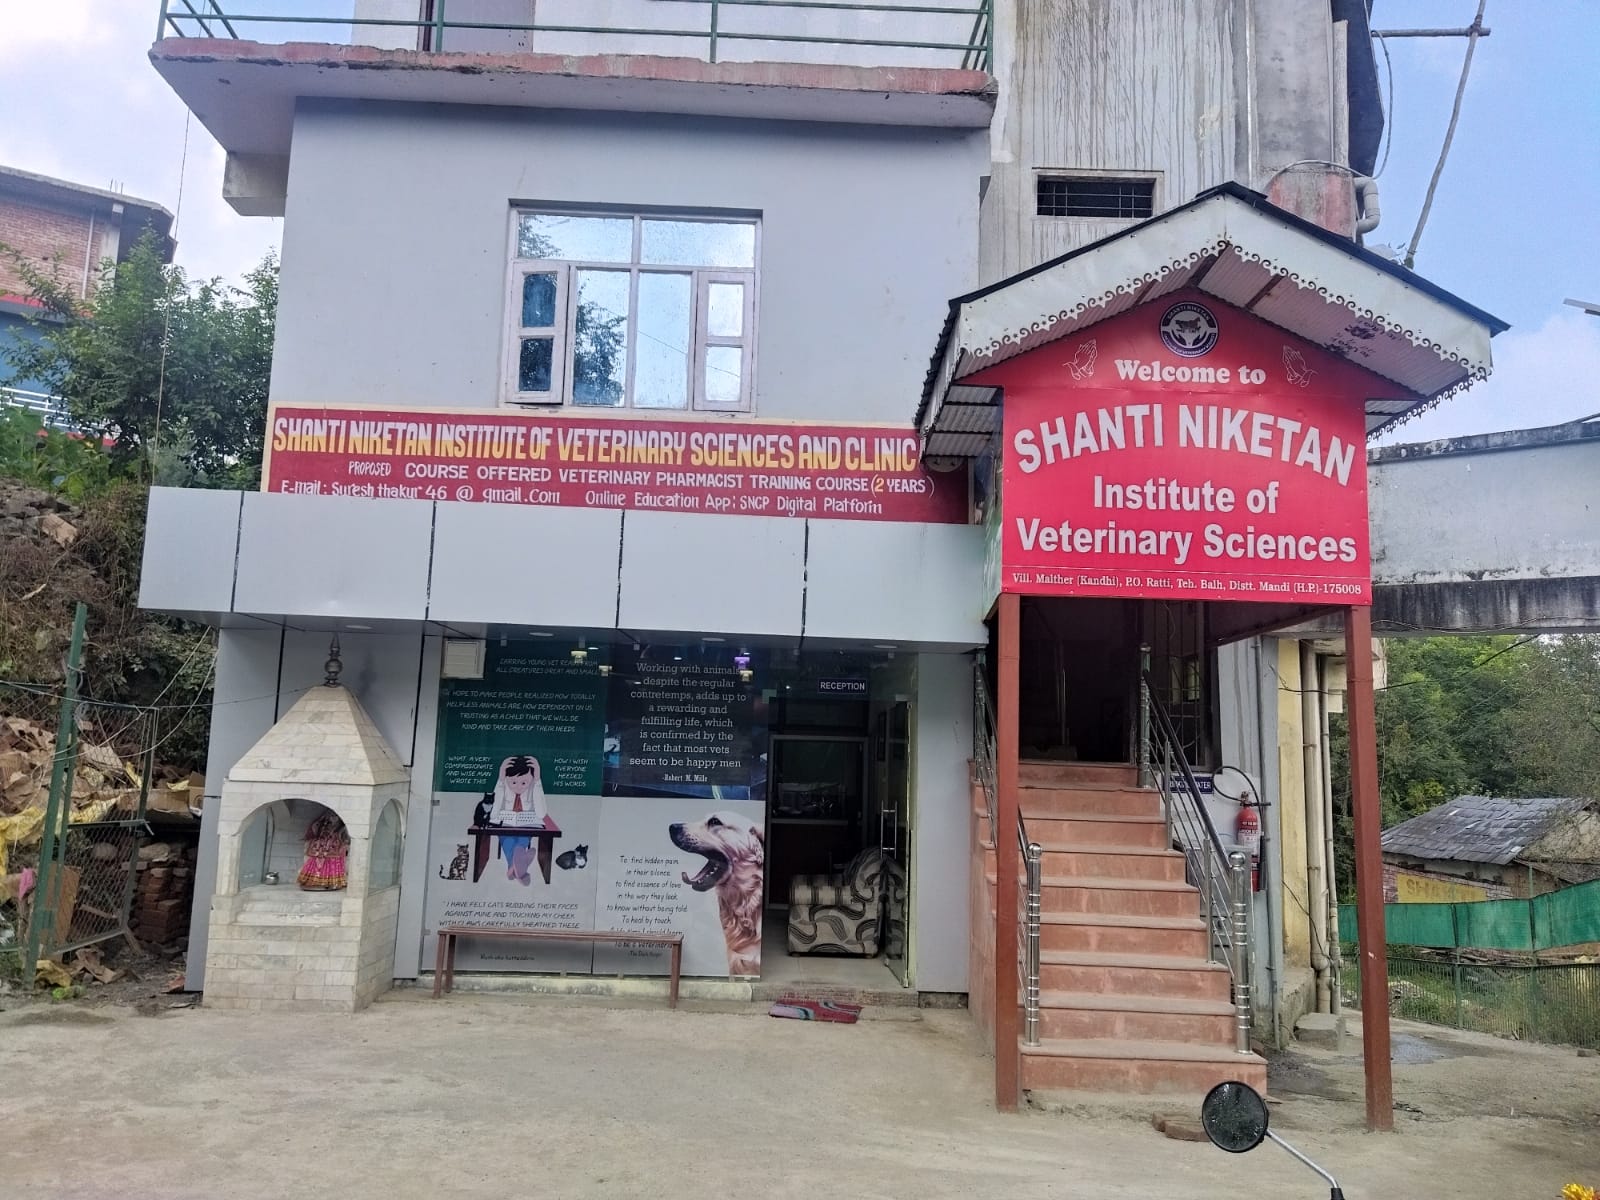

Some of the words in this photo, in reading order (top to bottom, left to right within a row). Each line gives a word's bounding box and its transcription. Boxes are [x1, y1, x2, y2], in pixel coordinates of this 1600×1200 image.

[1115, 360, 1231, 384] Welcome
[1239, 364, 1266, 385] to
[274, 417, 346, 454] SHANTI
[348, 420, 432, 456] NIKETAN
[434, 423, 527, 460] INSTITUTE
[529, 426, 553, 460] OF
[558, 428, 686, 465] VETERINARY
[690, 432, 794, 468] SCIENCES
[799, 434, 842, 470] AND
[845, 436, 916, 472] CLINIC
[1014, 404, 1163, 474] SHANTI
[1179, 405, 1356, 487] NIKETAN
[348, 460, 391, 477] PROPOSED
[405, 462, 468, 478] COURSE
[476, 466, 552, 482] OFFERED
[559, 469, 651, 485] VETERINARY
[656, 471, 744, 488] PHARMACIST
[749, 474, 812, 490] TRAINING
[816, 477, 868, 492] COURSE
[332, 481, 374, 496] Suresh
[425, 485, 447, 500] 46
[456, 485, 474, 502] @
[585, 490, 626, 506] Online
[635, 492, 699, 508] Education
[740, 496, 770, 510] SNCP
[777, 496, 816, 516] Digital
[824, 497, 882, 514] Platform
[1093, 475, 1235, 512] Institute
[1247, 481, 1279, 514] of
[1016, 518, 1192, 564] Veterinary
[1204, 524, 1356, 562] Sciences
[1012, 573, 1032, 583] Vill.
[1146, 578, 1172, 588] Ratti,
[1176, 579, 1196, 588] Teh.
[1200, 580, 1226, 591] Balh,
[1259, 582, 1290, 592] Mandi
[636, 662, 678, 675] Working
[680, 665, 700, 674] with
[643, 677, 680, 687] despite
[682, 678, 698, 686] the
[700, 679, 735, 689] regular
[820, 681, 865, 690] RECEPTION
[695, 692, 720, 700] adds
[722, 694, 734, 703] up
[657, 704, 706, 715] rewarding
[709, 705, 728, 714] and
[641, 716, 682, 728] fulfilling
[684, 716, 702, 728] life,
[705, 718, 733, 727] which
[639, 730, 648, 738] is
[650, 730, 700, 740] confirmed
[703, 731, 715, 742] by
[718, 732, 734, 740] the
[642, 742, 661, 752] fact
[663, 744, 682, 752] that
[683, 745, 707, 753] most
[710, 746, 730, 754] vets
[658, 758, 668, 766] to
[670, 756, 684, 766] be
[686, 756, 717, 770] happy
[719, 760, 741, 768] men
